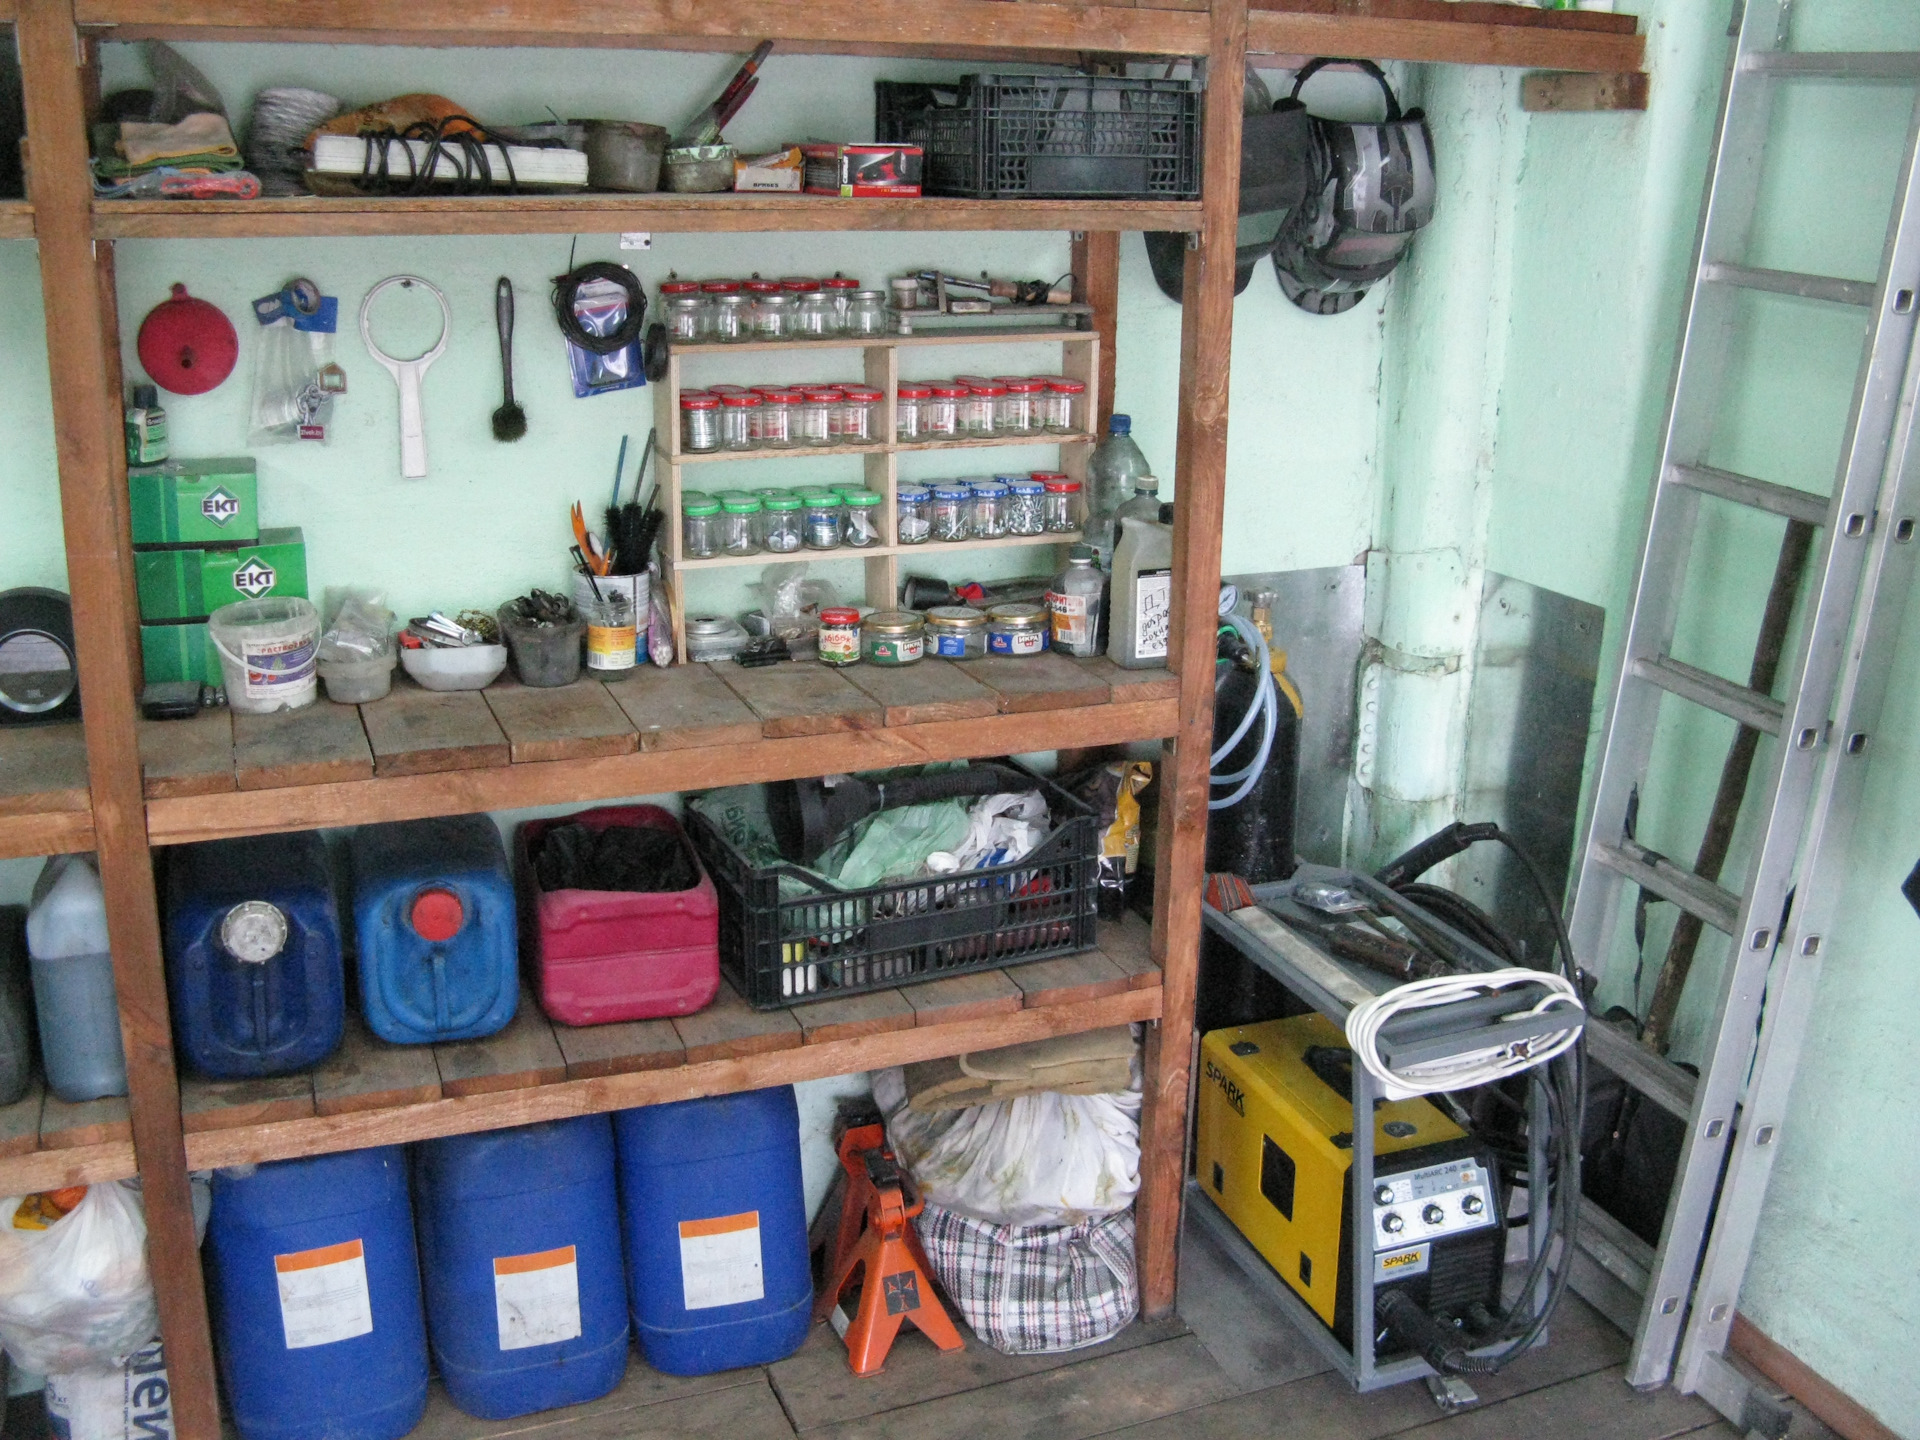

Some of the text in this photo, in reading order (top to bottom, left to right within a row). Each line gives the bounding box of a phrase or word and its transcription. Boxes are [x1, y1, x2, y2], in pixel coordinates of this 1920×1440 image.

[203, 499, 237, 513] EKT
[235, 571, 273, 587] EKT
[1205, 1061, 1245, 1113] SPARK
[1444, 1165, 1458, 1175] 240
[1383, 1251, 1419, 1267] SPARK
